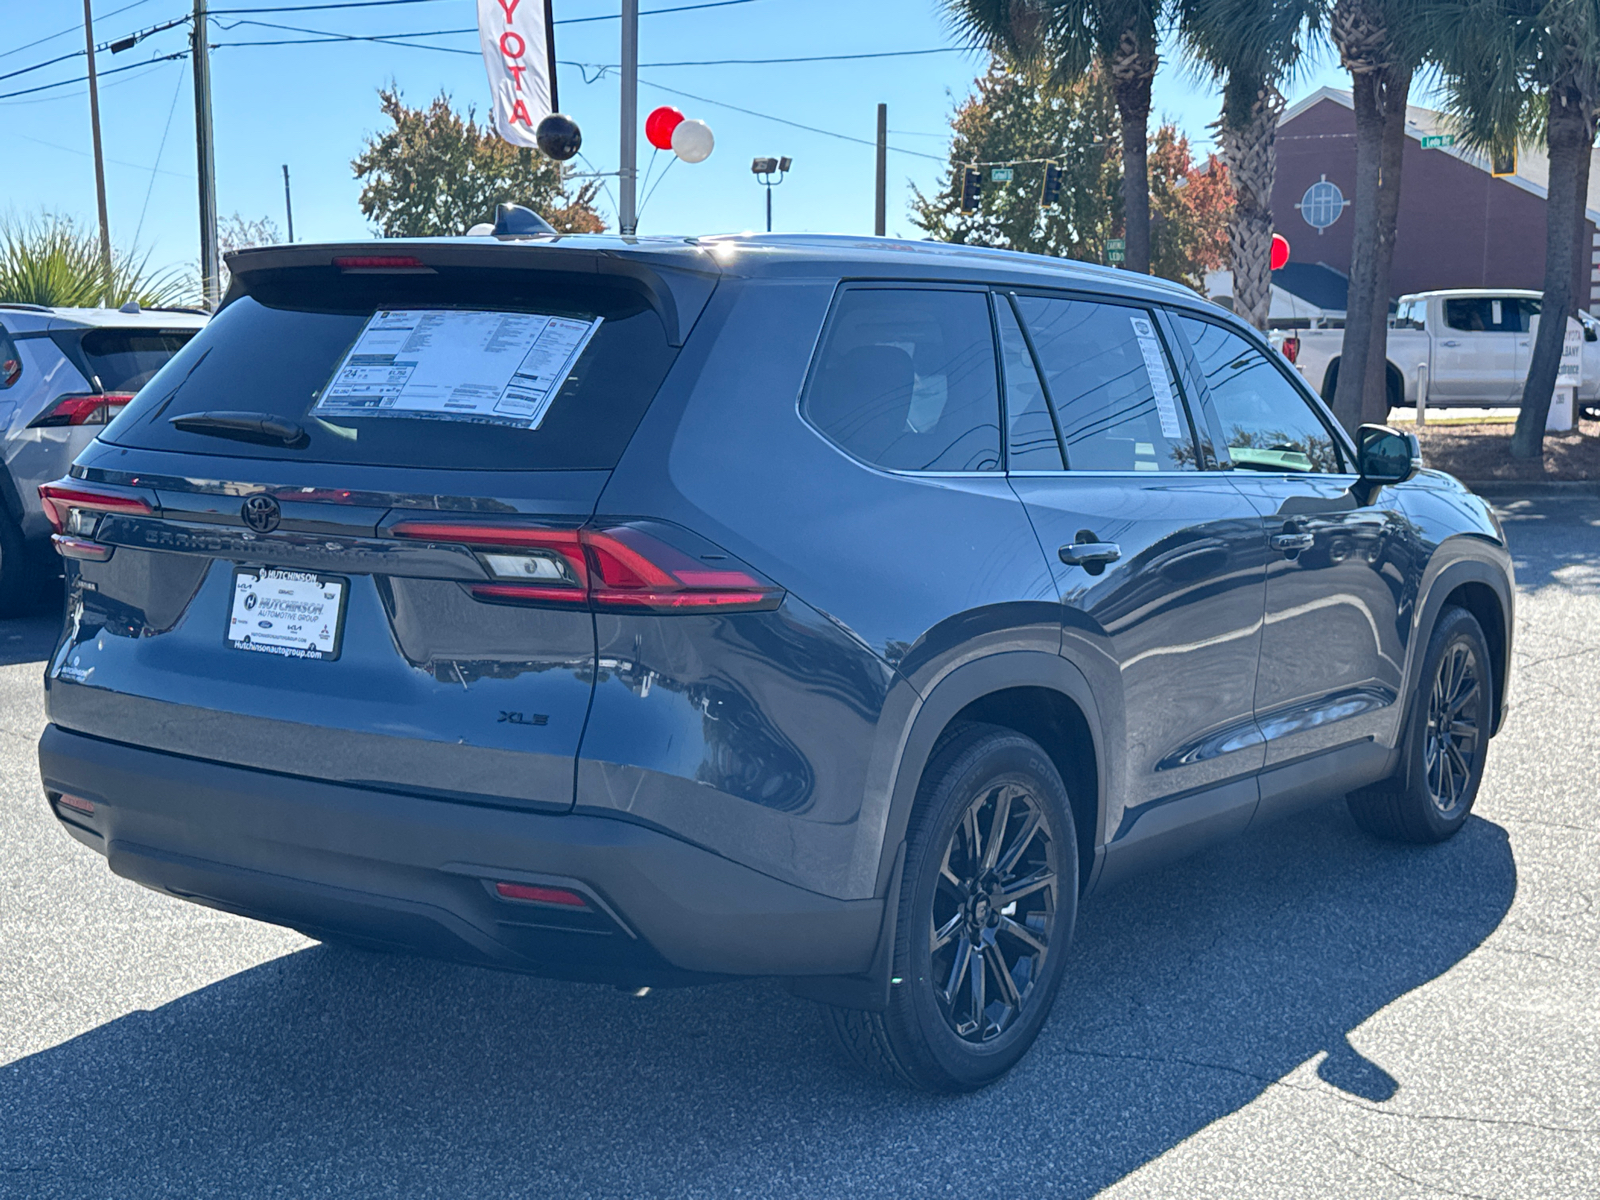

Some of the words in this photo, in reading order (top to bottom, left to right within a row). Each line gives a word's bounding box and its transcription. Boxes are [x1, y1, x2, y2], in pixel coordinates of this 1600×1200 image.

[497, 0, 533, 127] YOTA
[1427, 137, 1440, 147] Ledo
[268, 570, 318, 582] HUTCHINSON
[258, 597, 324, 615] HUTCHINSON
[257, 609, 297, 620] AUTOMOTIVE
[297, 614, 319, 623] GROUP
[234, 641, 322, 659] Hutchinsonautogroup.com
[497, 710, 549, 726] XLE
